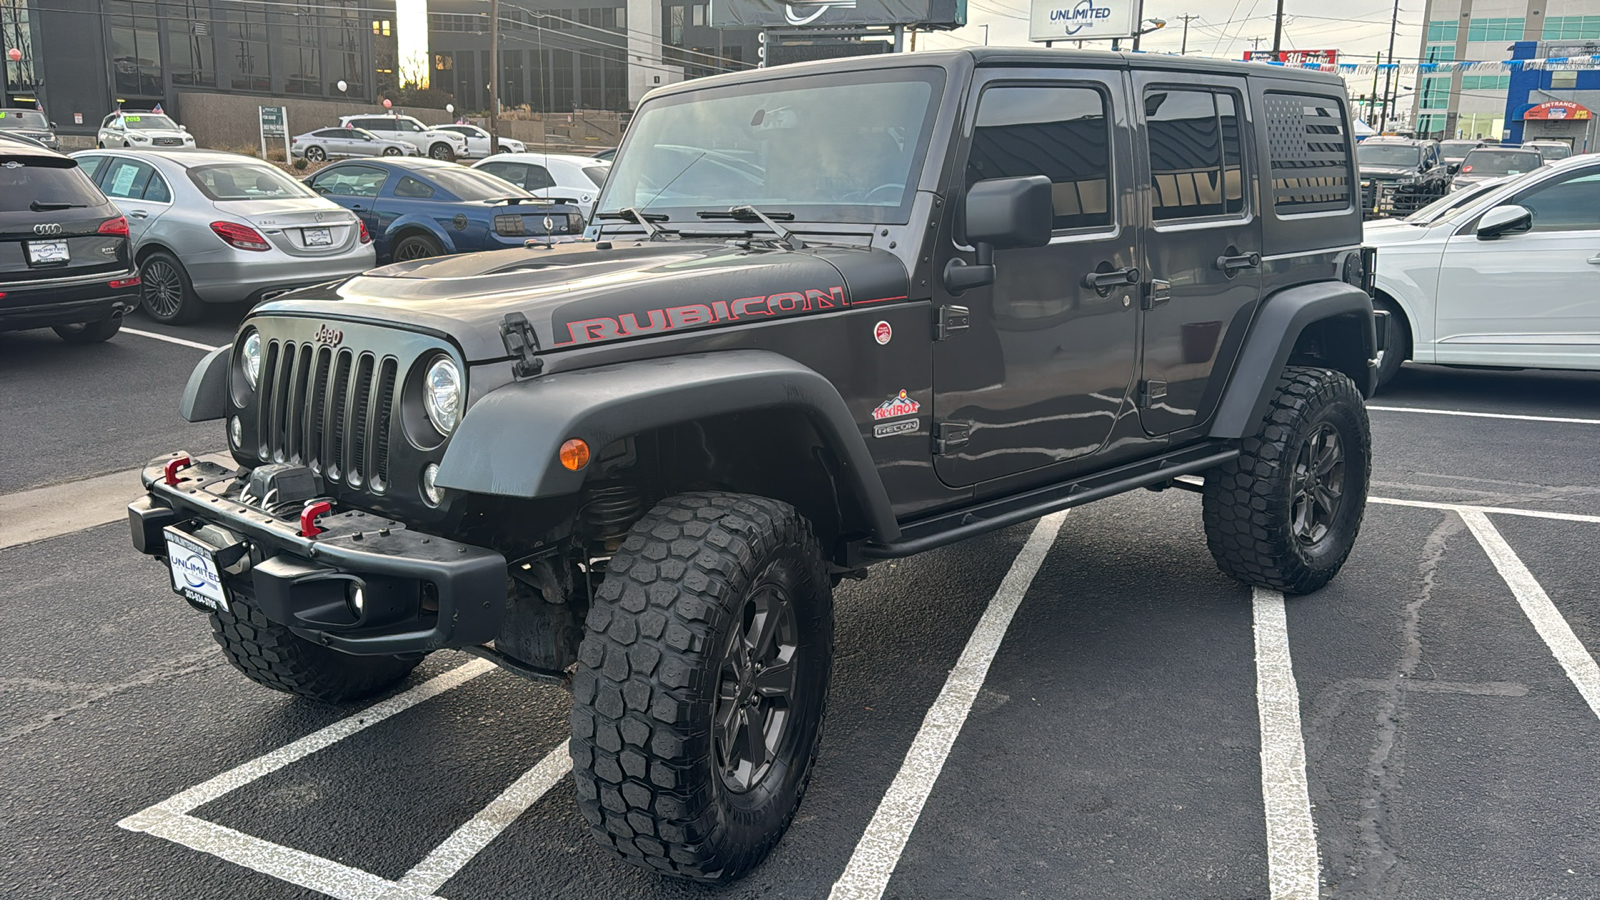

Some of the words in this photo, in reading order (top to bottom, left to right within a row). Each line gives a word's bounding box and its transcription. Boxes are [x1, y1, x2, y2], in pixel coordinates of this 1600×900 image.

[1050, 8, 1111, 21] UNLIMITED
[1541, 101, 1577, 109] ENTRANCE
[554, 286, 850, 346] RUBICON
[313, 323, 344, 348] Jeep
[878, 421, 917, 434] RECON
[171, 555, 221, 583] UNLIMITED
